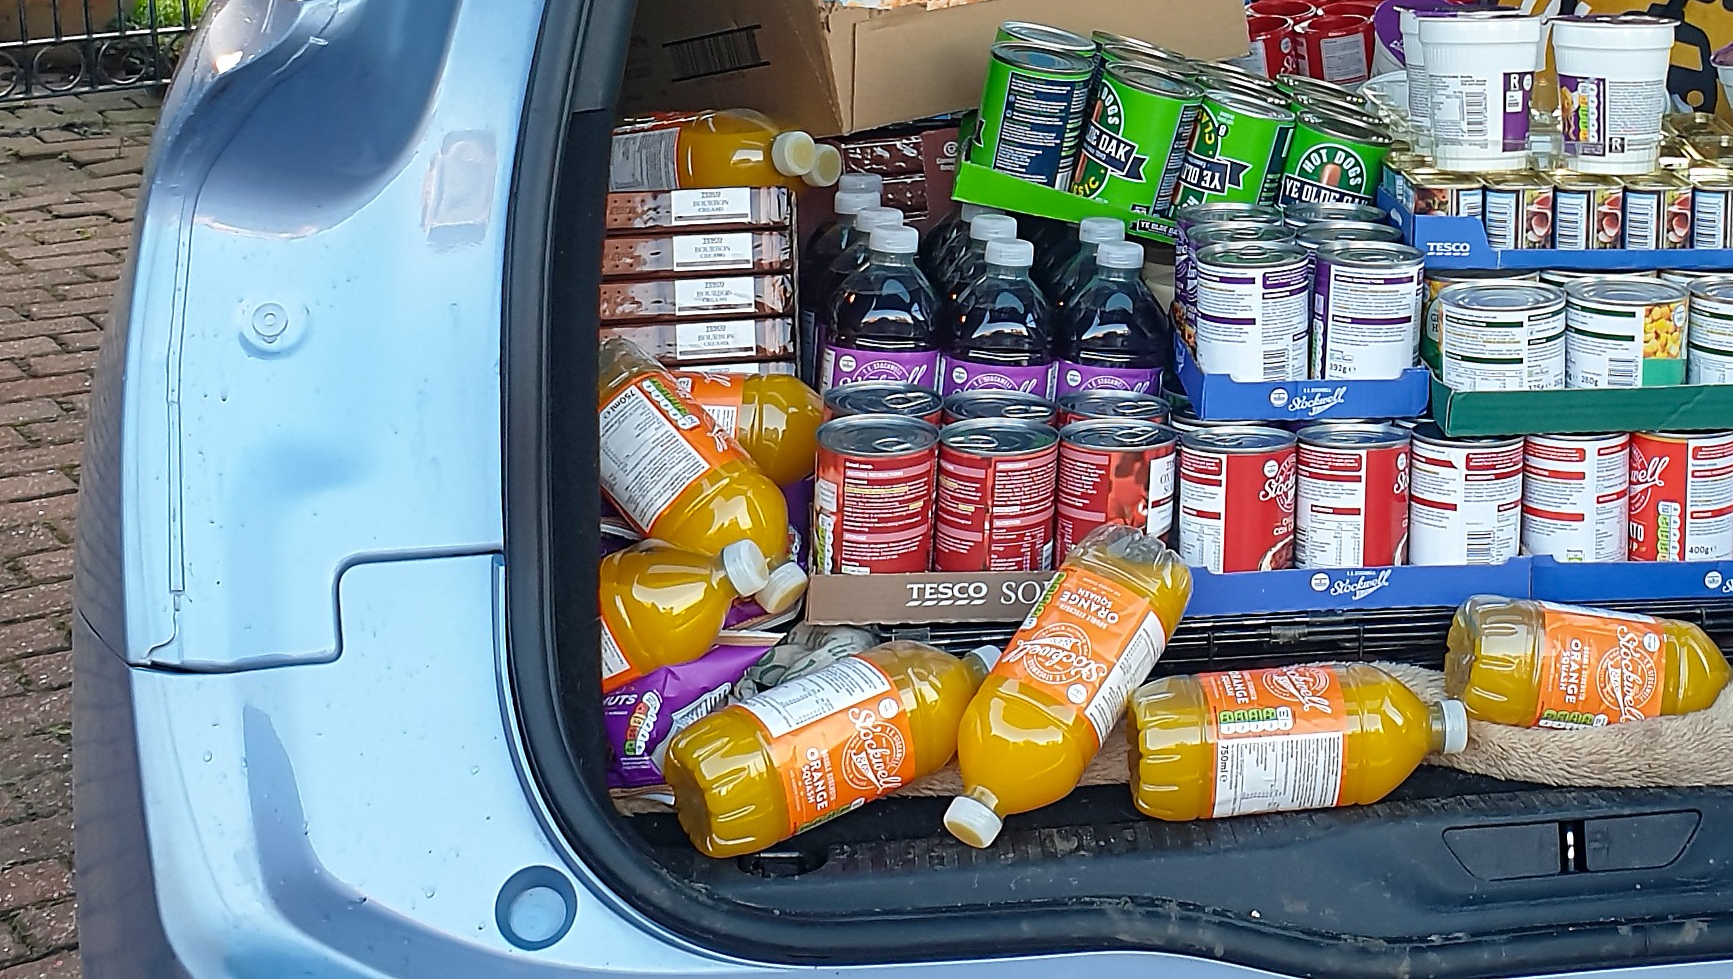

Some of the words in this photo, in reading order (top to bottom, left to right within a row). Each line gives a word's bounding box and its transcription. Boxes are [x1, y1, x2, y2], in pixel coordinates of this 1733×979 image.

[1101, 87, 1120, 125] DOGS
[1099, 134, 1132, 162] OAK
[1180, 163, 1200, 184] OLD
[1201, 169, 1222, 189] YE
[1302, 149, 1328, 173] HOT
[1334, 151, 1362, 186] DOGS
[692, 199, 729, 207] BOURBON
[1286, 178, 1300, 198] YE
[1302, 185, 1340, 203] OLDE
[694, 245, 731, 253] BOURBON
[1426, 242, 1470, 253] TESCO
[696, 289, 732, 297] BOURBON
[698, 333, 734, 341] BOURBON
[612, 387, 637, 413] 750ml
[1288, 387, 1347, 412] Stockwell
[1259, 475, 1296, 501] Stock
[1688, 545, 1710, 555] 400g
[906, 582, 988, 599] TESCO
[1330, 569, 1392, 596] Stockwell
[1060, 591, 1119, 624] ORANGE
[1078, 587, 1113, 609] SQUASH
[1001, 645, 1108, 682] Stockwell
[1560, 651, 1570, 691] SQUASH
[1565, 639, 1582, 703] ORANGE
[1617, 625, 1645, 721] Stockwell
[1228, 671, 1250, 704] ORANGE
[848, 707, 902, 789] Stockwell
[1220, 745, 1229, 773] 750ml
[802, 765, 816, 803] SQUASH
[806, 747, 828, 811] ORANGE
